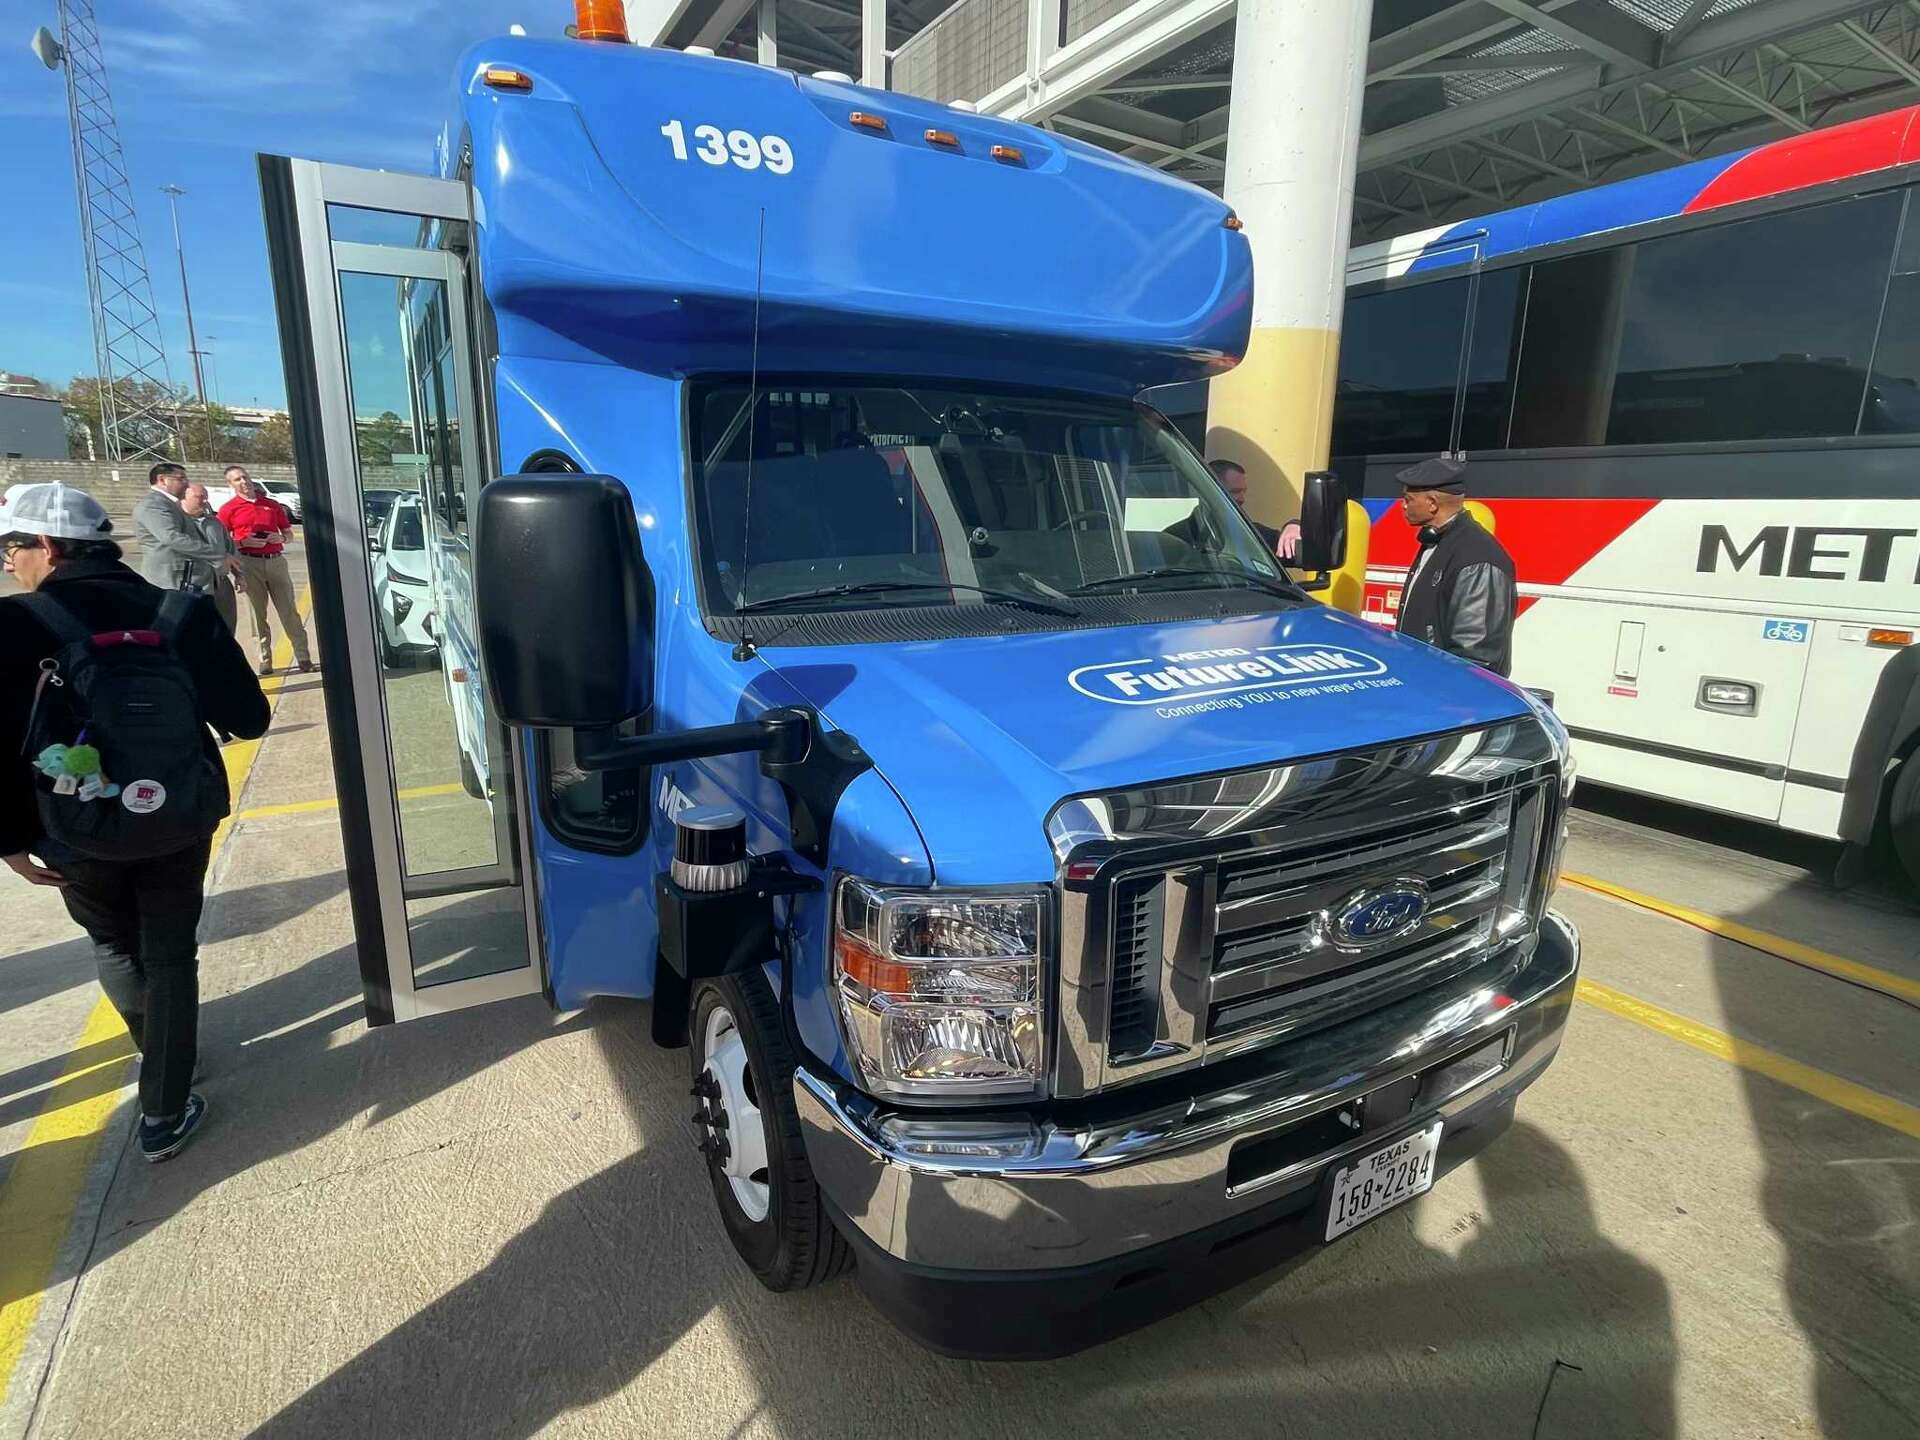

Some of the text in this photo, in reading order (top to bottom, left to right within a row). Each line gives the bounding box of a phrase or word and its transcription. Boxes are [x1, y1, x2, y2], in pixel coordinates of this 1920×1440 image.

[661, 120, 794, 175] 1399
[1696, 524, 1920, 585] MET
[1104, 650, 1365, 696] FutureLink
[1156, 677, 1404, 719] Connecting YOU to new ways of travel
[1370, 1141, 1410, 1169] TEXAS
